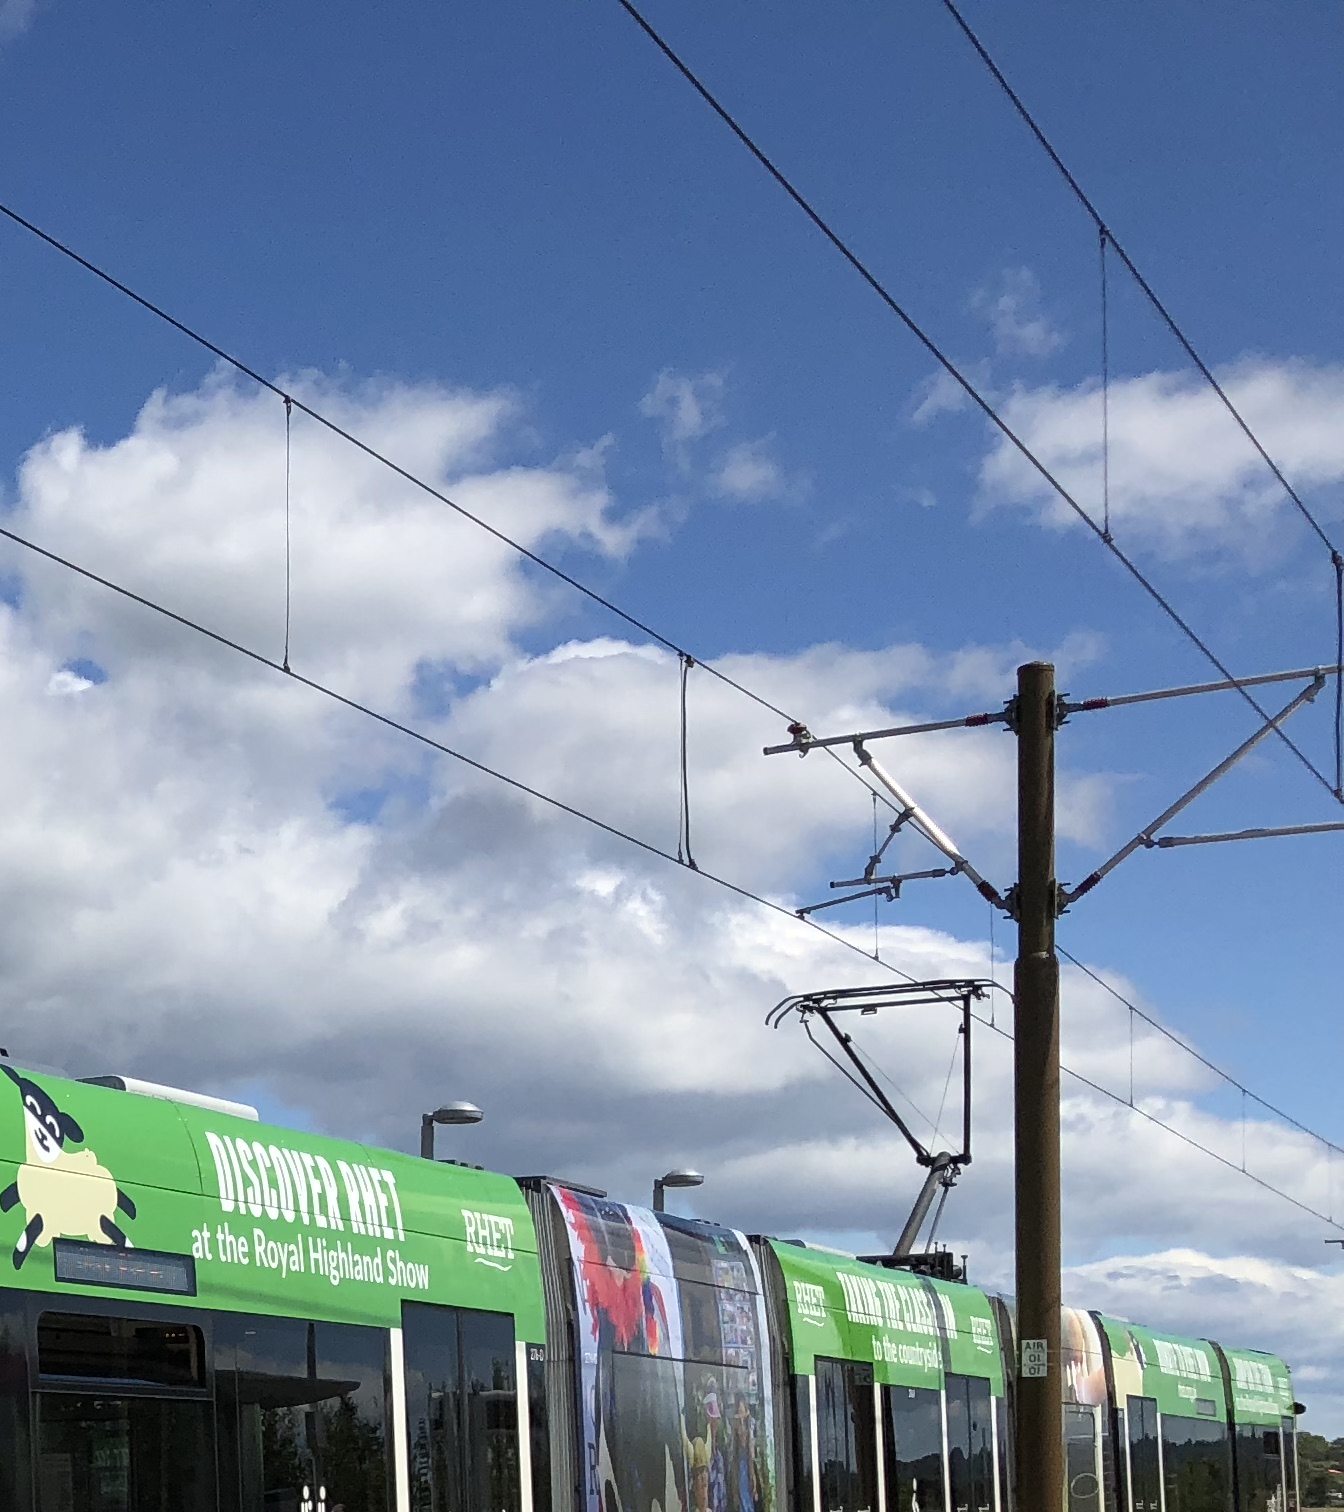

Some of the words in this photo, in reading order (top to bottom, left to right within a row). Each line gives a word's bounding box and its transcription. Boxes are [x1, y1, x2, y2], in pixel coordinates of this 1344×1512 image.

[205, 1131, 345, 1232] DISCOVER
[336, 1160, 406, 1241] RHET
[191, 1222, 213, 1260] at
[216, 1222, 249, 1265] the
[253, 1228, 305, 1278] Royal
[308, 1237, 384, 1286] Highland
[387, 1250, 429, 1289] Show
[461, 1209, 515, 1259] RHET
[793, 1281, 826, 1317] RHET
[876, 1280, 904, 1330] THE
[872, 1335, 882, 1361] to
[883, 1334, 897, 1363] the
[1025, 1341, 1044, 1351] AIR
